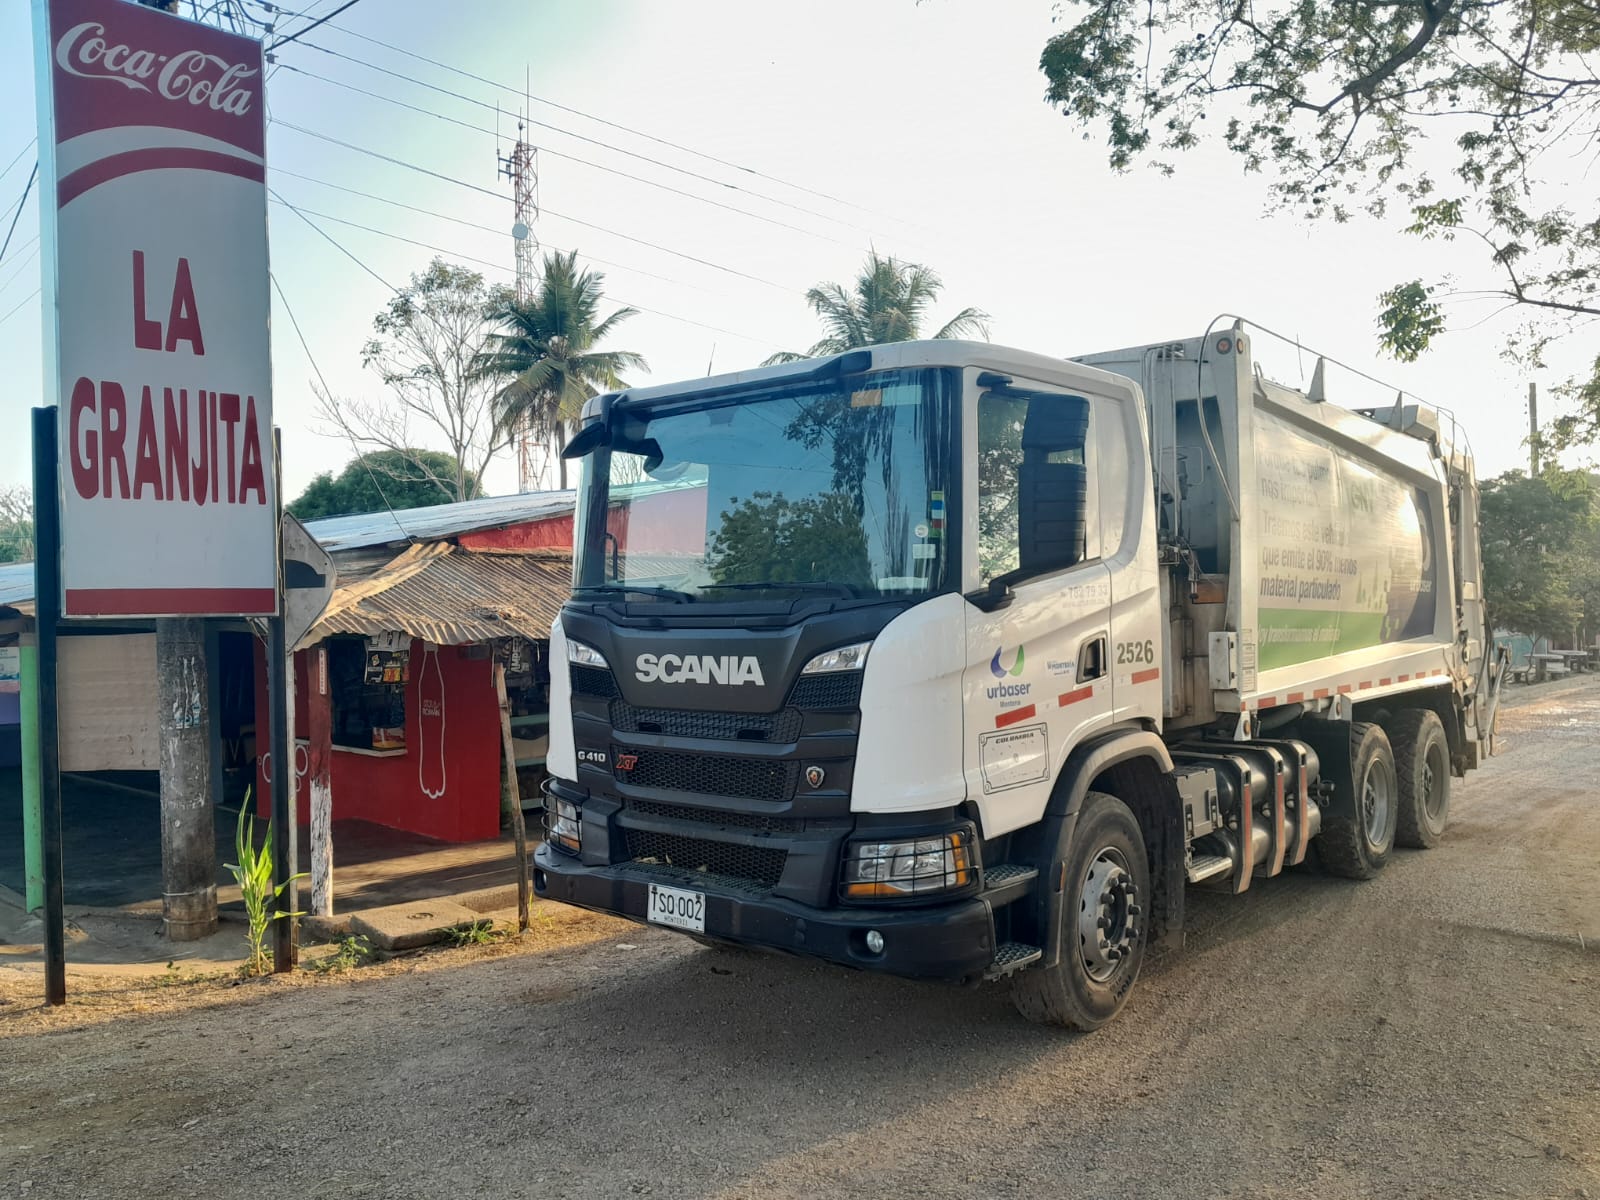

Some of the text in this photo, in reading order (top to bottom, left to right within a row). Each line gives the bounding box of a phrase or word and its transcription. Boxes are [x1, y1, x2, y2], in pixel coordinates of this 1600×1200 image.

[55, 21, 259, 117] Coca-Cola
[132, 249, 205, 356] LA
[69, 376, 267, 506] GRANJITA
[1262, 546, 1279, 570] que
[1281, 546, 1305, 570] emite
[1260, 573, 1298, 598] material
[1117, 639, 1154, 664] 2526
[635, 653, 765, 686] SCANIA
[986, 682, 1032, 699] urbaser
[577, 751, 606, 763] G 410
[678, 896, 703, 921] 002
